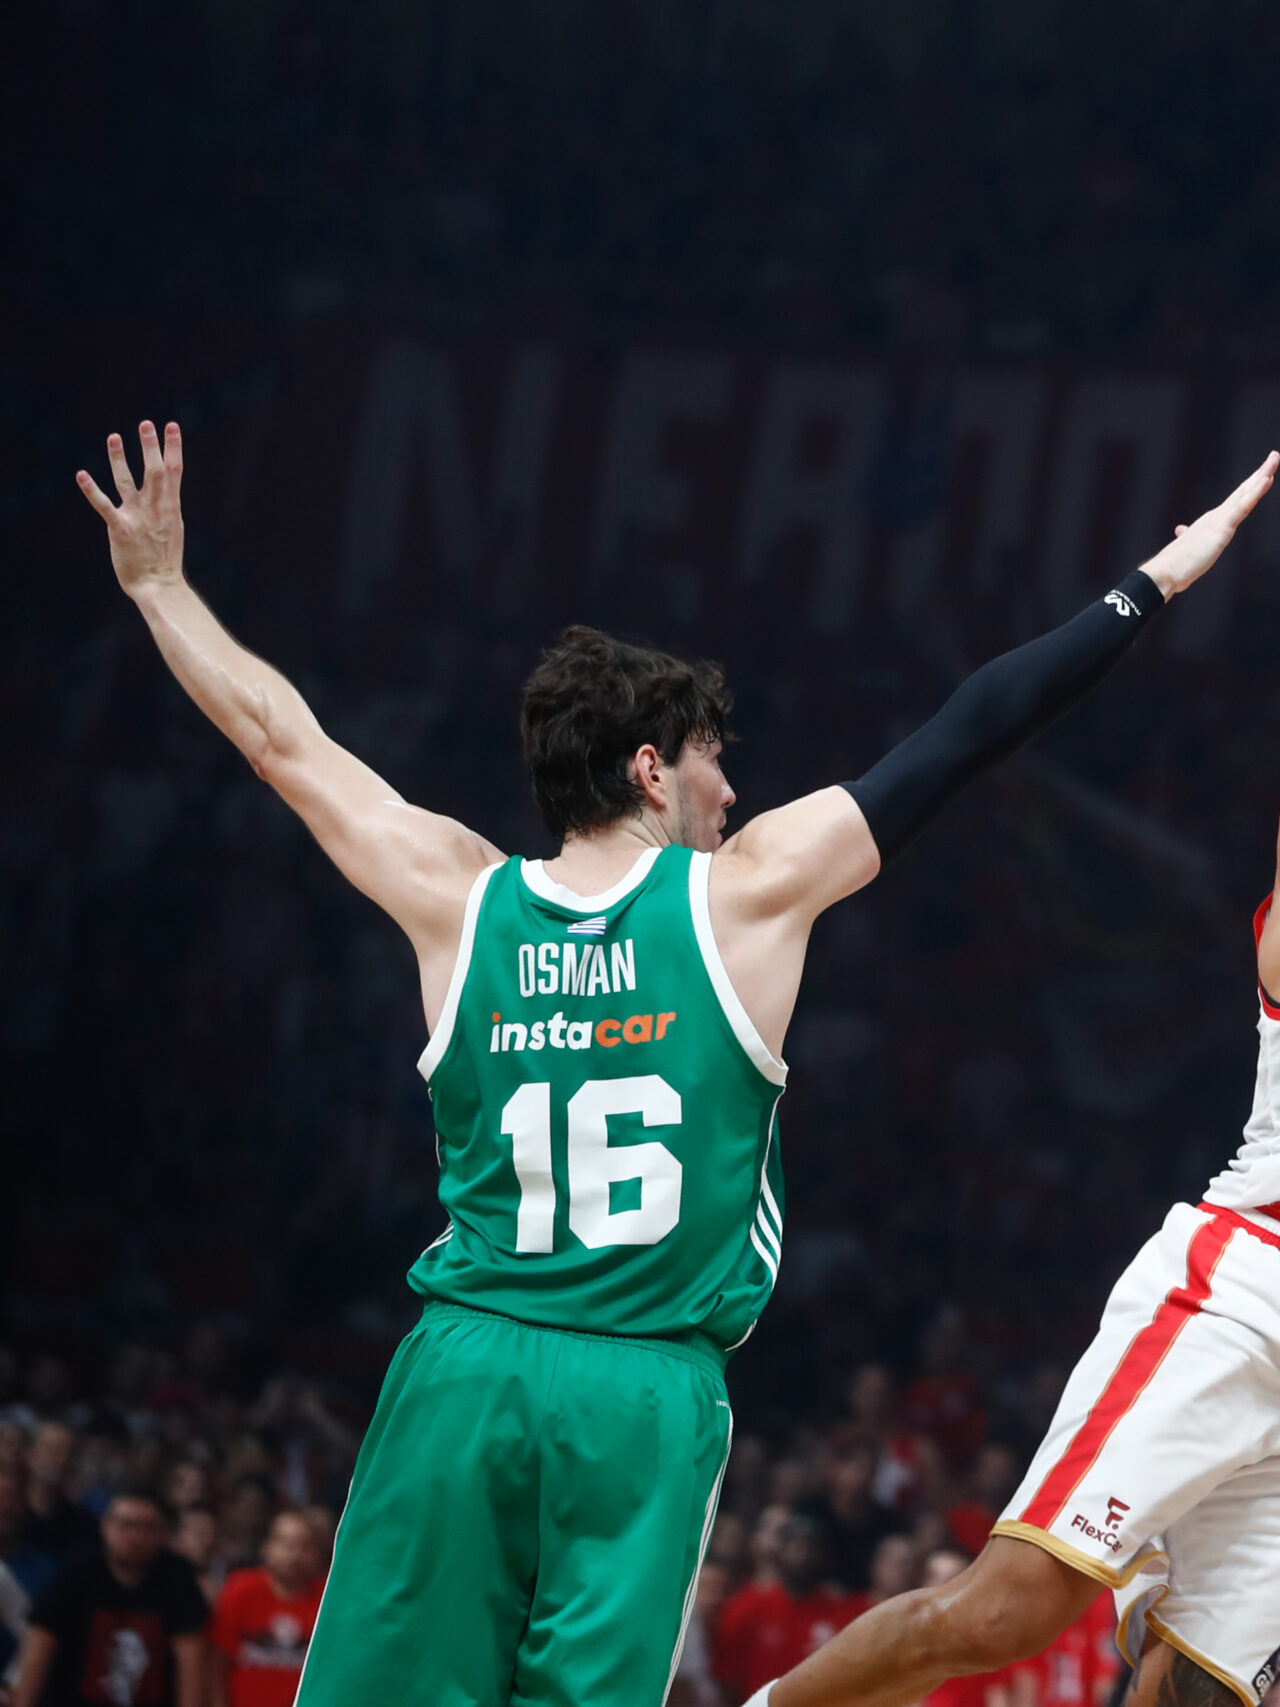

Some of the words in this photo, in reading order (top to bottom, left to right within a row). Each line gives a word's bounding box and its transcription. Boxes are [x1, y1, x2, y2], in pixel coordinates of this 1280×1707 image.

[518, 938, 637, 997] OSMAN
[489, 1010, 677, 1053] instacar
[500, 1074, 683, 1254] 16
[1071, 1514, 1122, 1553] FlexCa
